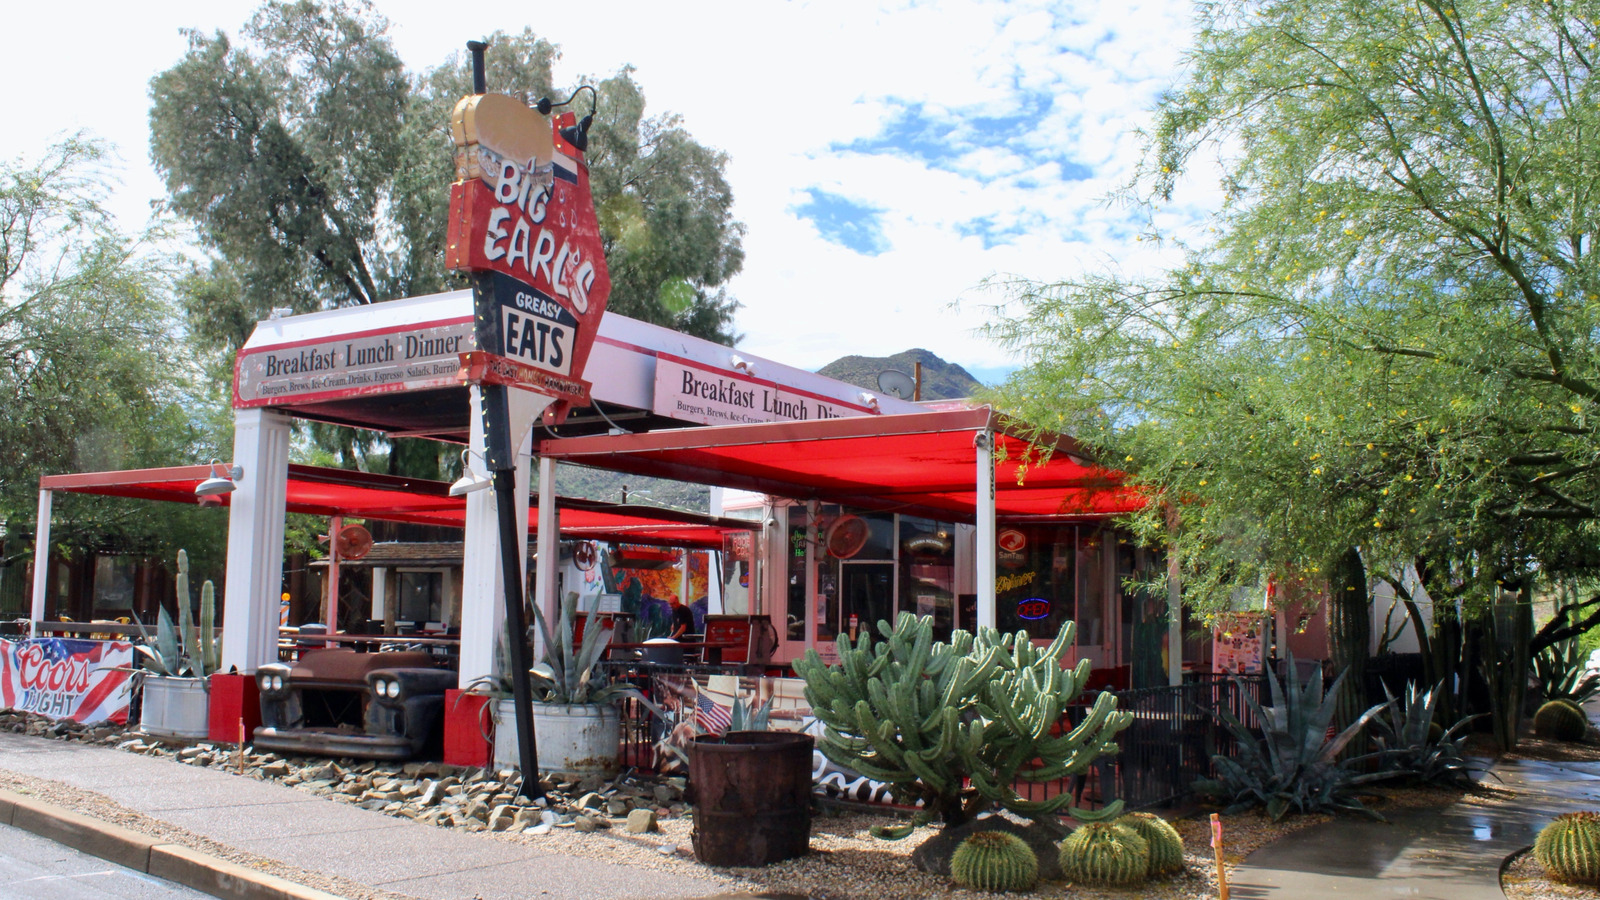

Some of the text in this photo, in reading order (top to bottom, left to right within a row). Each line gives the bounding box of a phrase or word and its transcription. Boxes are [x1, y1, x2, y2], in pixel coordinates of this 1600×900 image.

[494, 156, 549, 223] BIG
[515, 291, 562, 320] GREASY
[266, 334, 463, 377] Breakfast Lunch Dinner
[506, 312, 565, 368] EATS
[676, 400, 705, 415] Burgers,
[706, 406, 728, 420] Brews,
[681, 370, 755, 409] Breakfast
[763, 389, 807, 420] Lunch
[1017, 603, 1051, 616] OPEN
[18, 645, 89, 693] Coors
[24, 691, 74, 715] LIGHT
